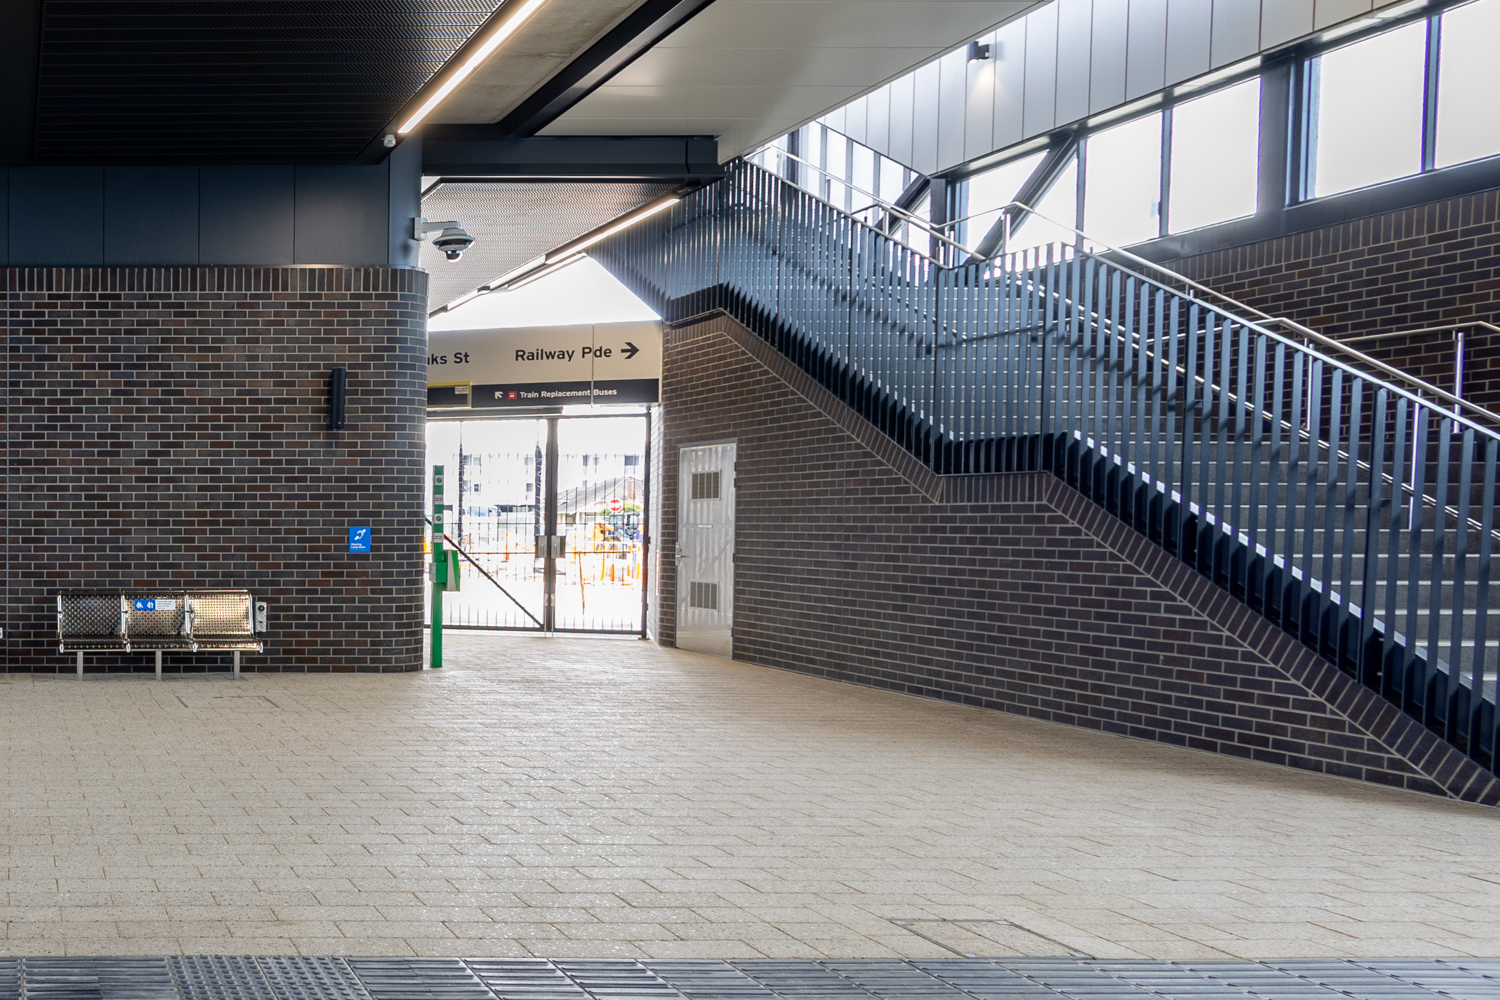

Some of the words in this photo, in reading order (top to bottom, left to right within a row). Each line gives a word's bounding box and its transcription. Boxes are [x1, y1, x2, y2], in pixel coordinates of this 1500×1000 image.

[453, 351, 470, 364] St
[515, 348, 575, 362] Railway
[581, 346, 612, 359] Pde
[520, 391, 539, 399] Train
[541, 389, 591, 398] Replacement
[593, 388, 618, 396] Buses
